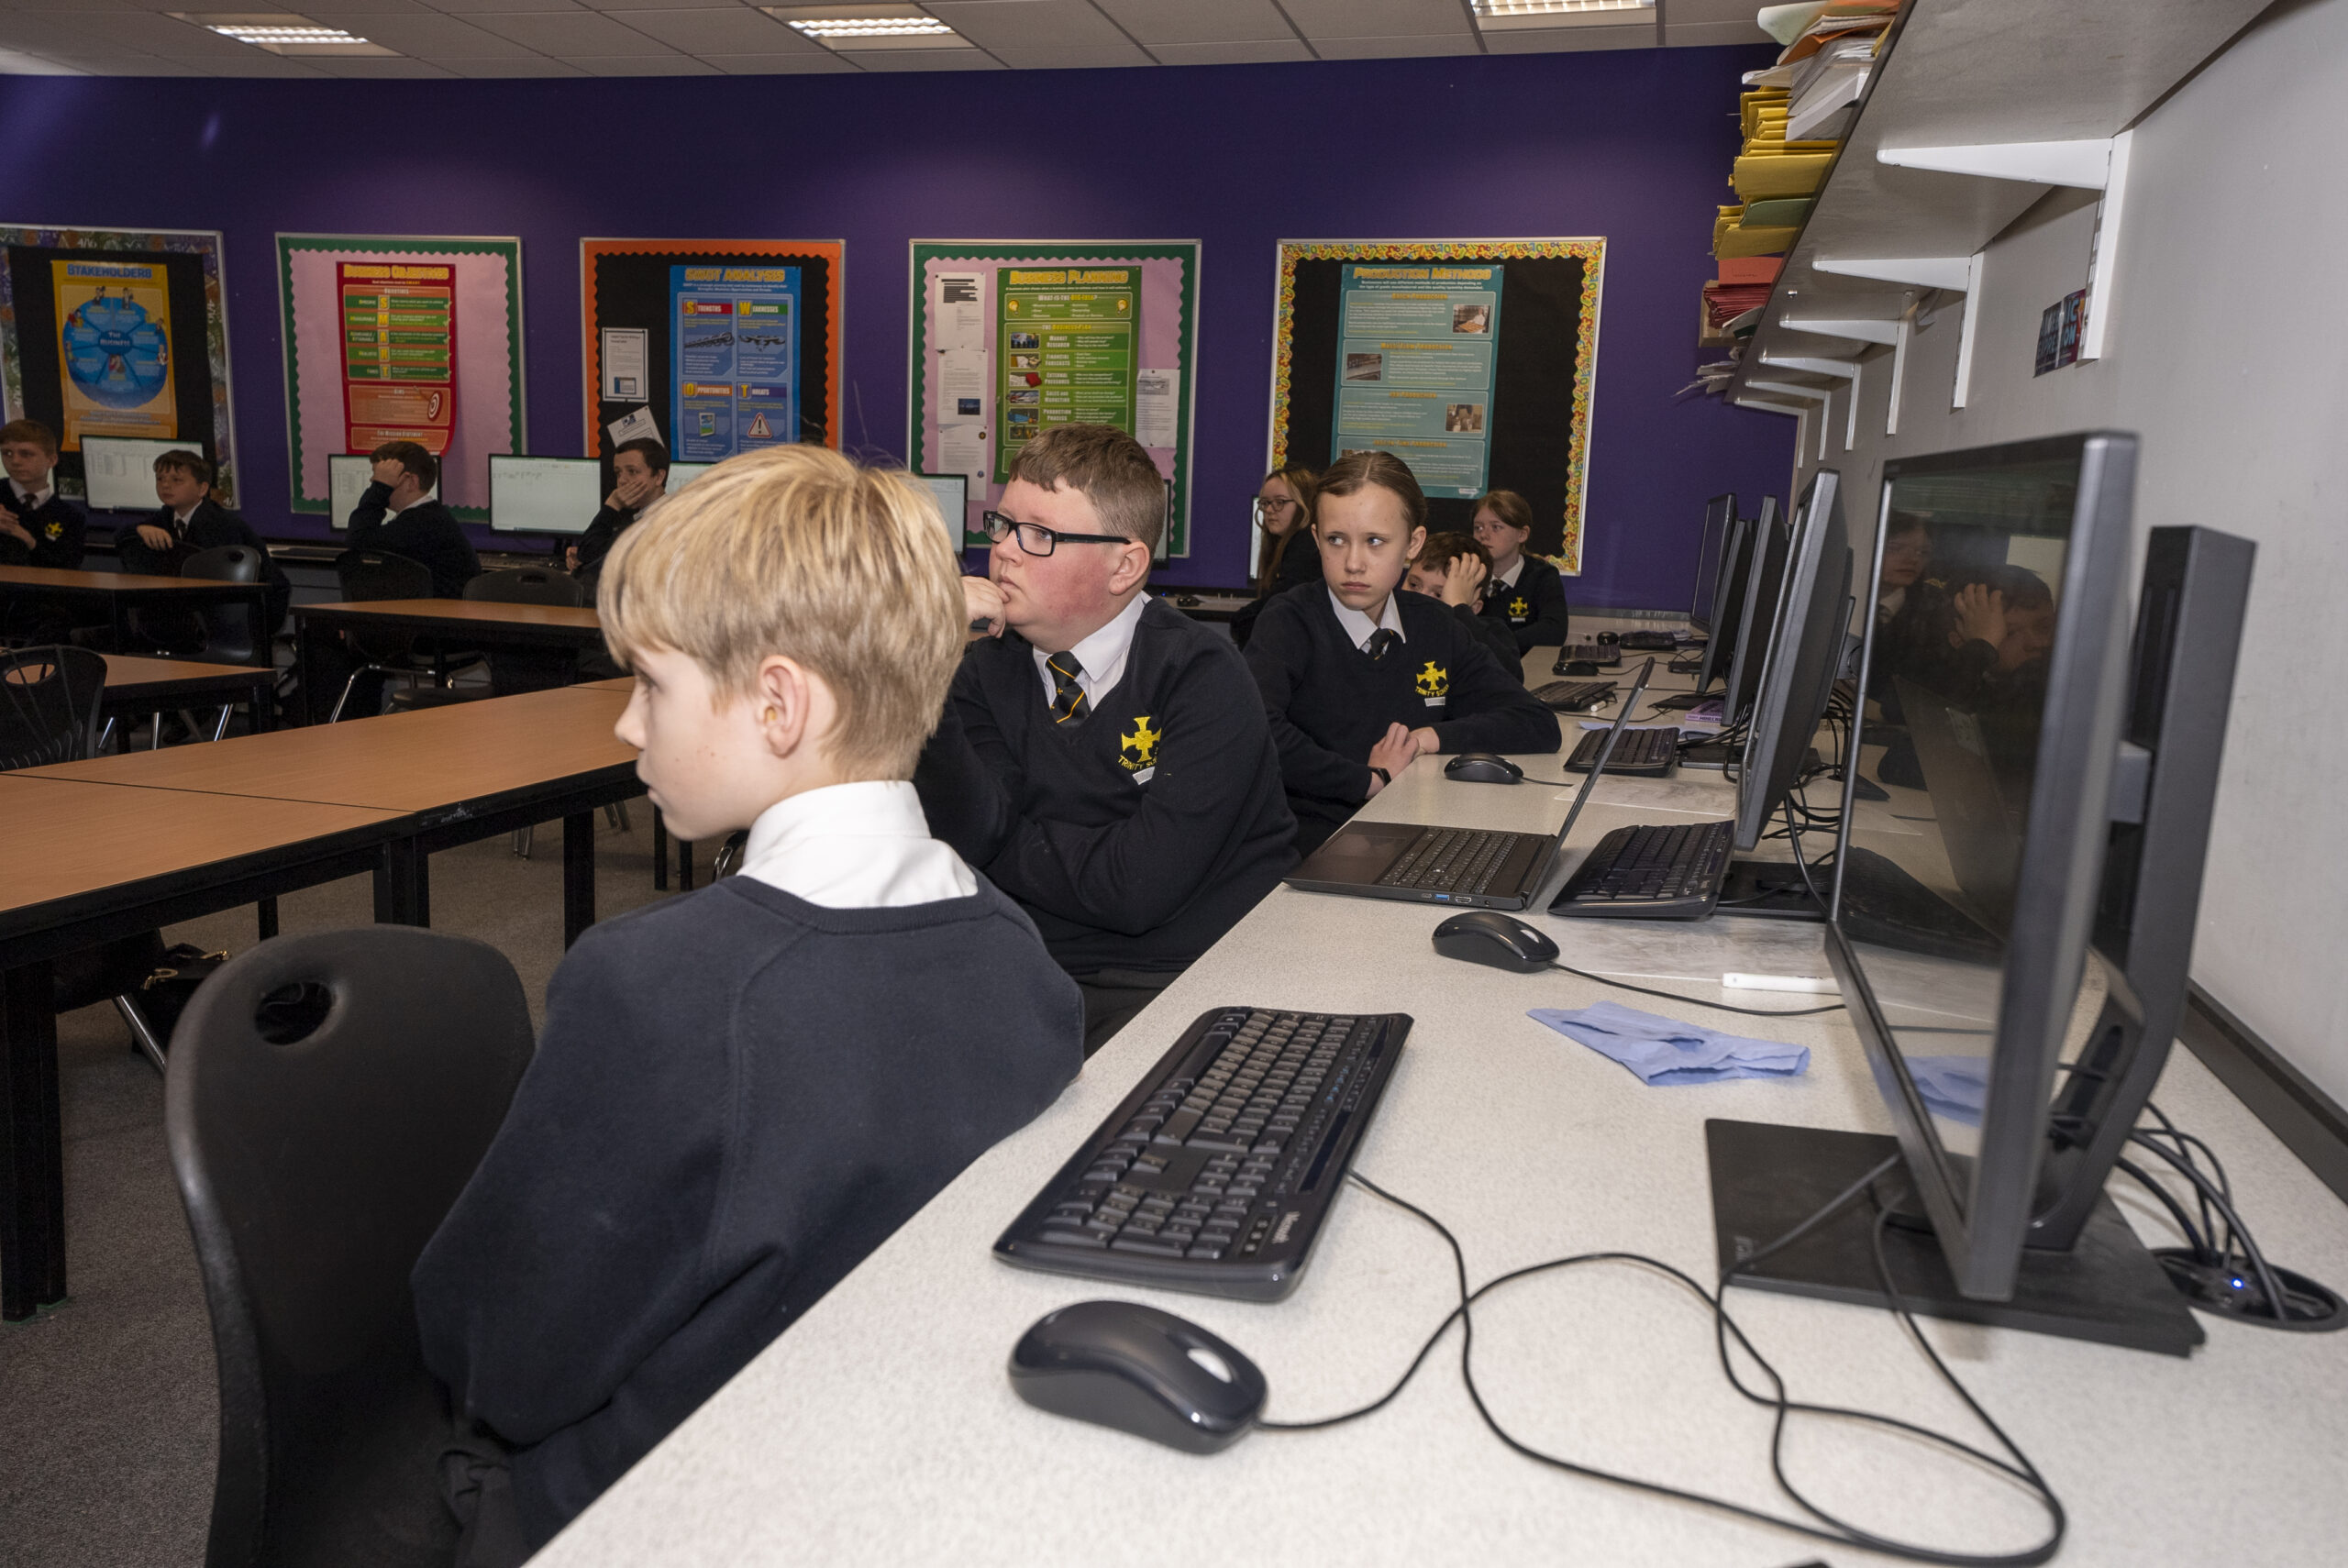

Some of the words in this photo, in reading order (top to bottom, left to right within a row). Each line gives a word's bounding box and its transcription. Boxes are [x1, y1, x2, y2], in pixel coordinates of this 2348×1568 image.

[67, 263, 153, 279] STAKEHOLDERS
[343, 264, 390, 278] BUSINESS
[392, 265, 449, 280] OBJECTIVES
[685, 268, 722, 282] SWOT
[723, 269, 785, 282] ANALYSIS
[1009, 271, 1066, 284] BUSINESS
[1067, 270, 1129, 284] PLANNING
[1353, 267, 1429, 280] PRODUCTION
[1431, 268, 1492, 280] METHODS
[380, 297, 388, 308] S
[379, 315, 388, 325] M
[380, 331, 387, 342] A
[1118, 755, 1143, 771] TRINITY
